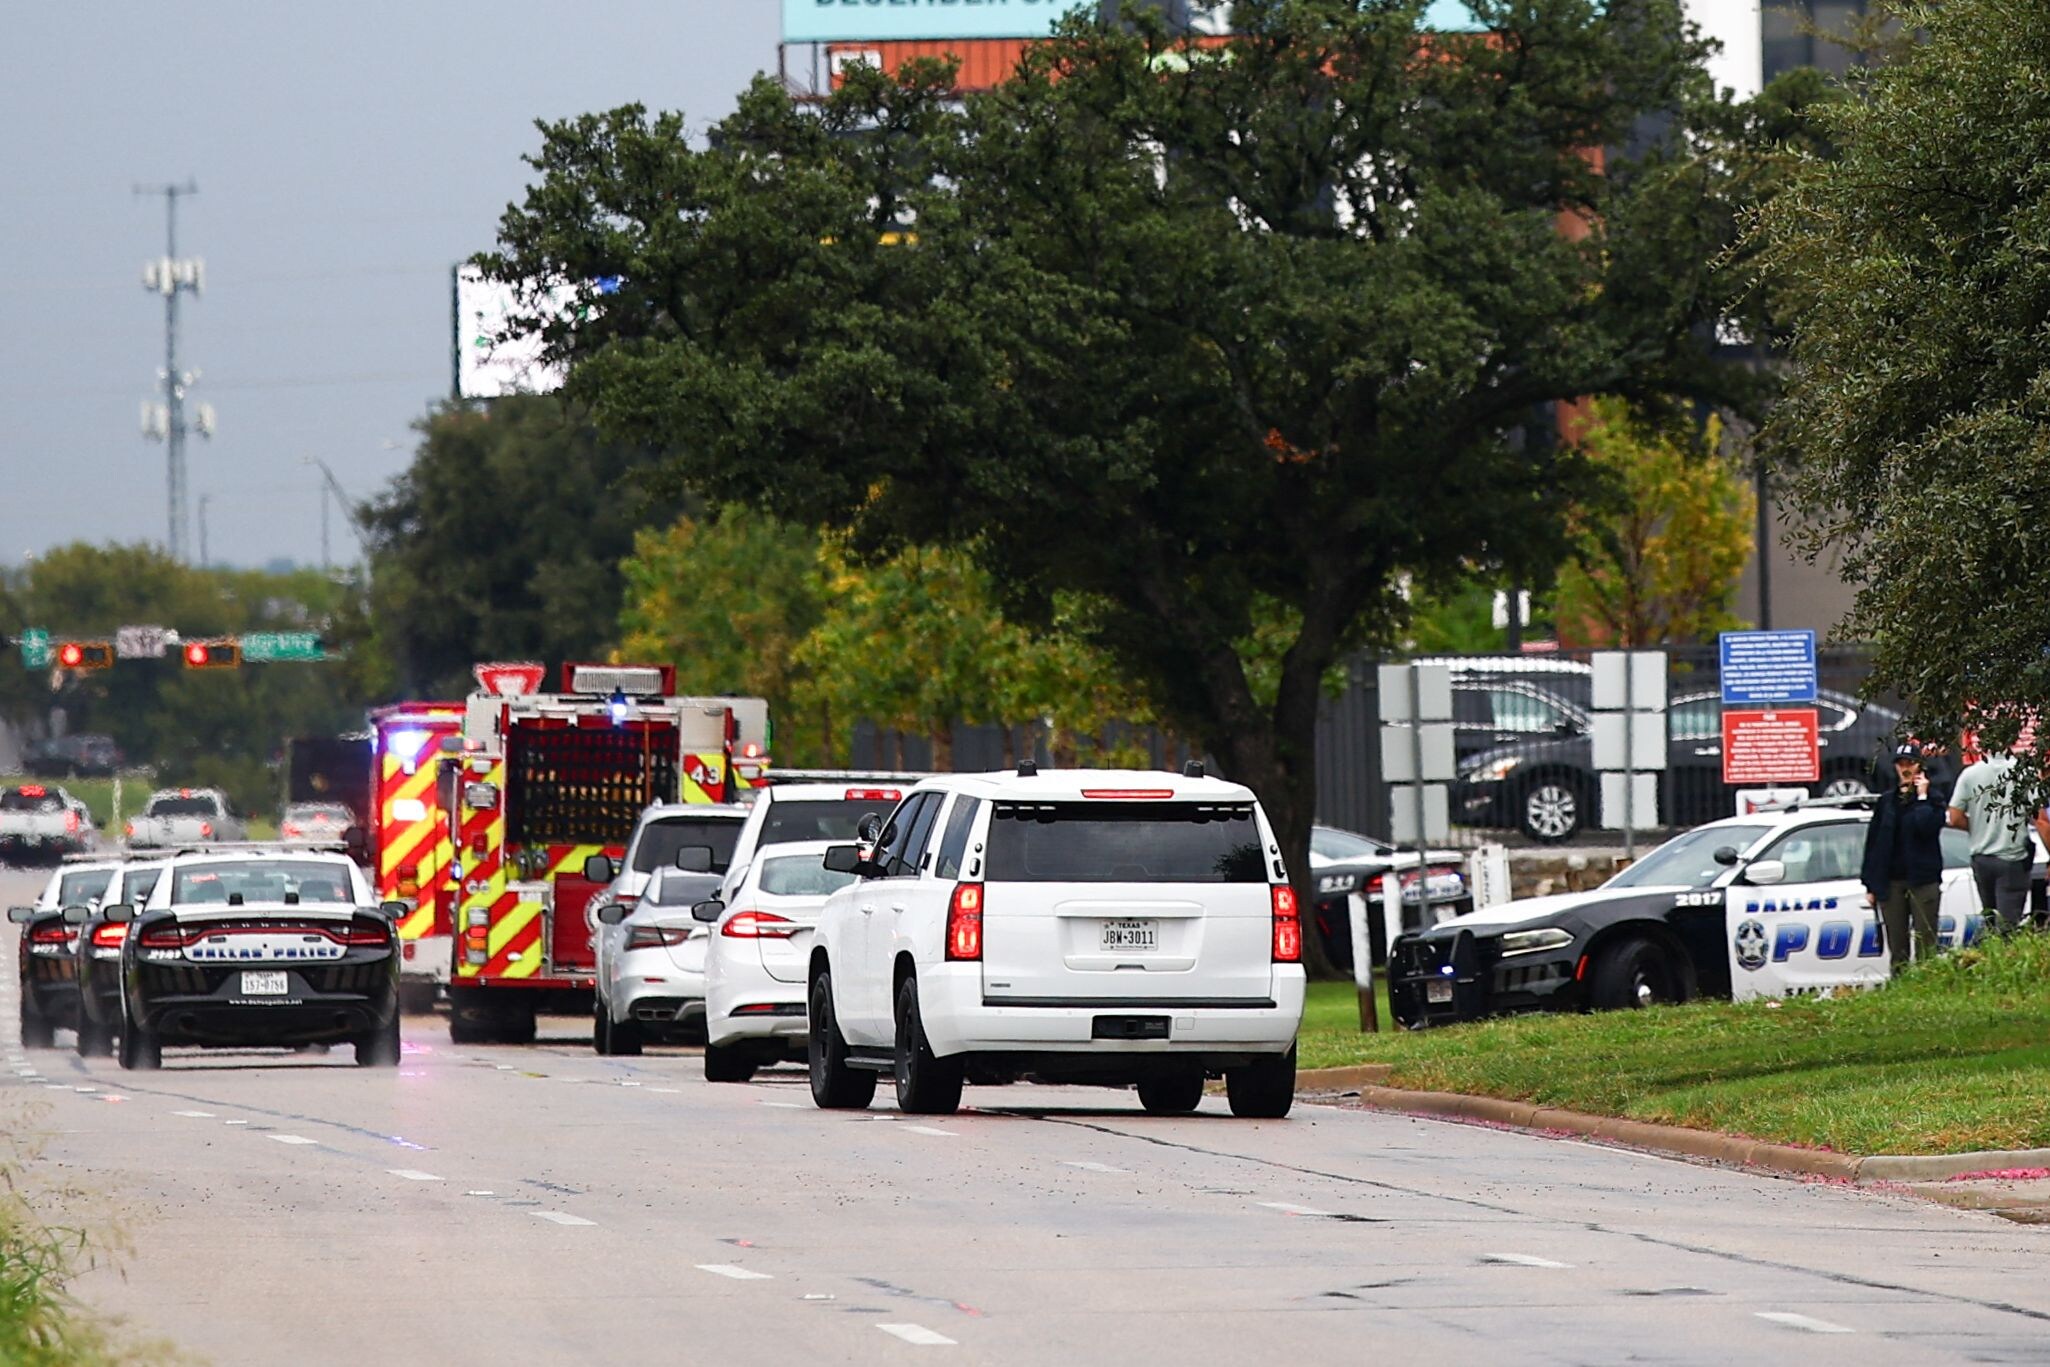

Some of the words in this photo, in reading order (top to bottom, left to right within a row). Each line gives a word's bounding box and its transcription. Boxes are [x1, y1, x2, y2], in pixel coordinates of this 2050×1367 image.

[690, 765, 721, 785] 43
[1675, 892, 1722, 907] 2017
[1745, 897, 1839, 913] DALLAS
[193, 948, 263, 958] DALLAS
[273, 947, 338, 958] POLICE
